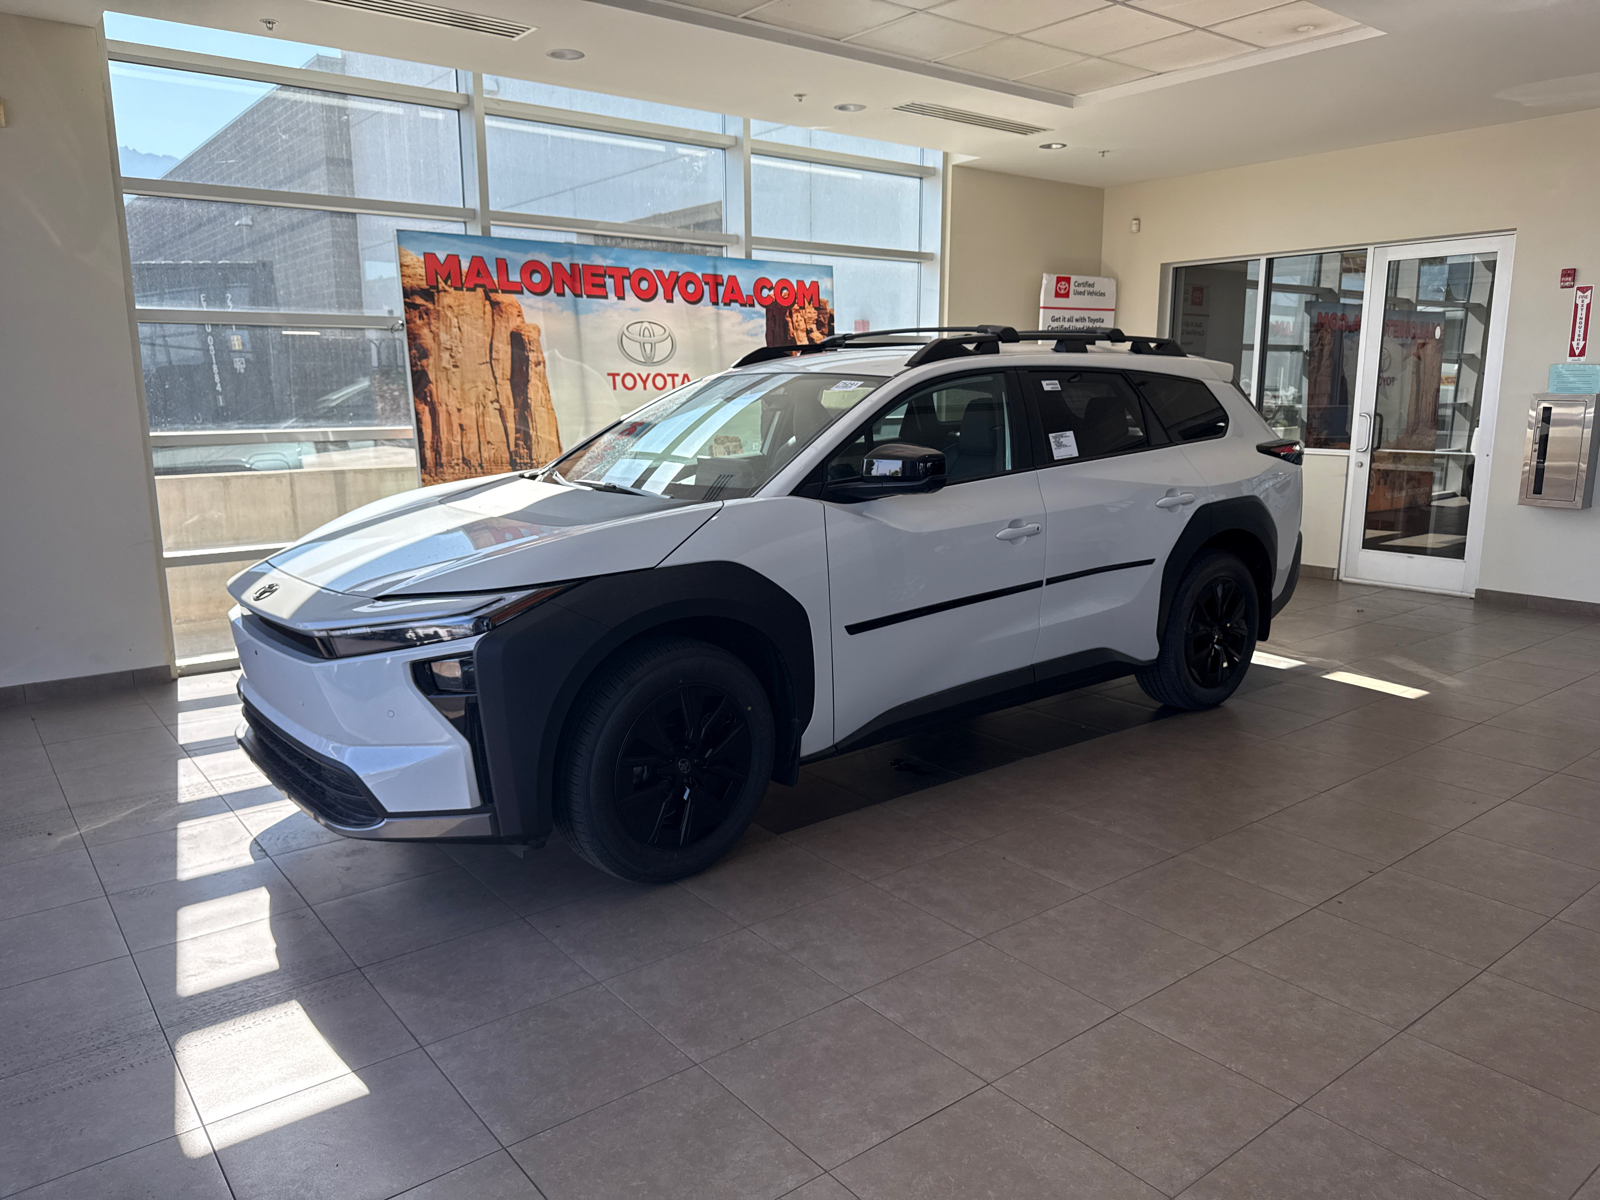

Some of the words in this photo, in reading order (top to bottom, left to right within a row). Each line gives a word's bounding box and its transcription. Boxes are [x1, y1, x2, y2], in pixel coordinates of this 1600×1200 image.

[423, 252, 820, 308] MALONETOYOTA.COM
[1051, 315, 1061, 323] Get
[1062, 315, 1066, 323] it
[1087, 316, 1105, 325] Toyota
[1576, 299, 1585, 351] EXTINGUISHER
[606, 372, 692, 391] TOYOTA
